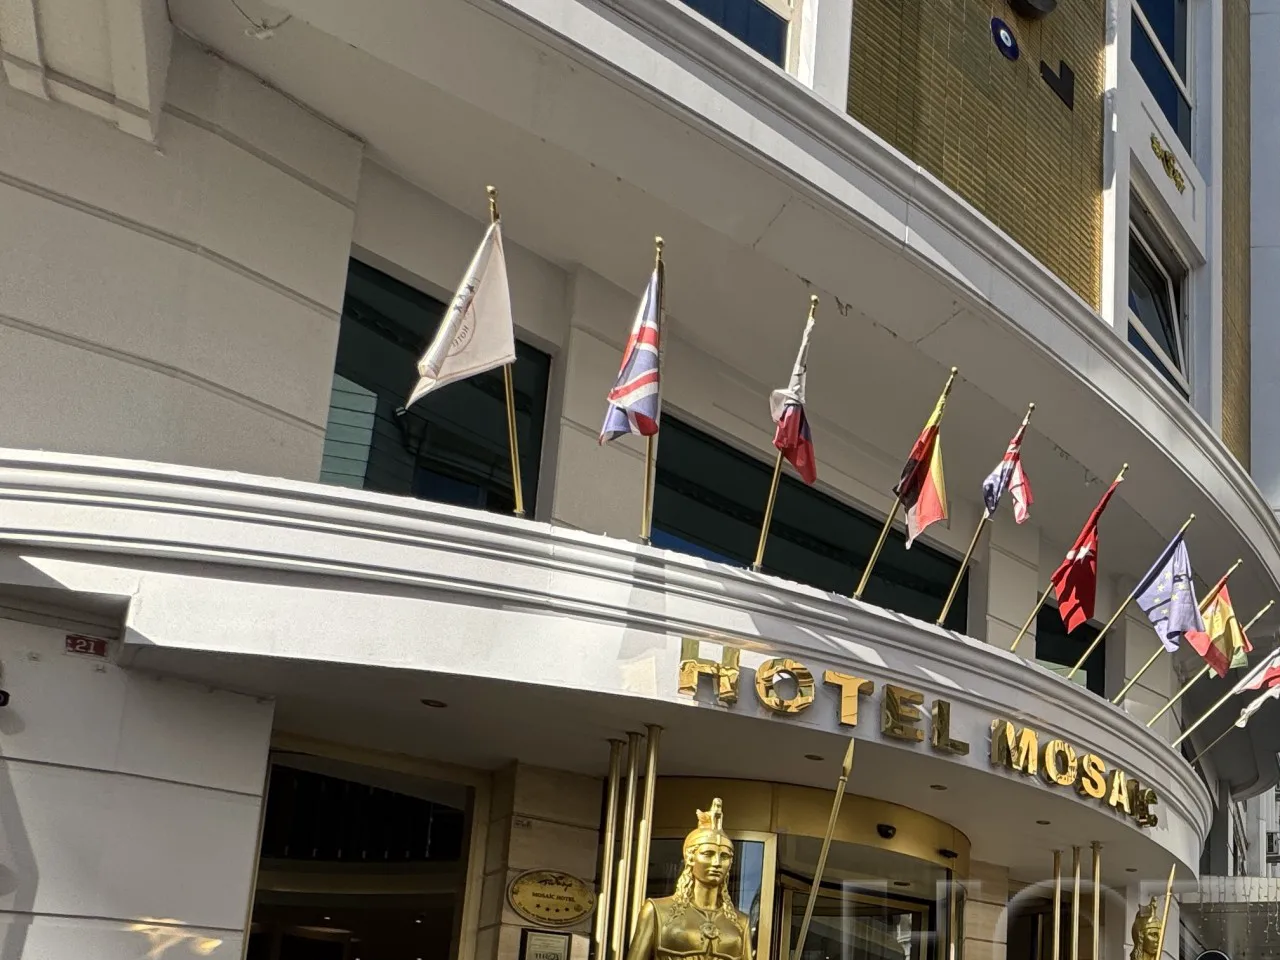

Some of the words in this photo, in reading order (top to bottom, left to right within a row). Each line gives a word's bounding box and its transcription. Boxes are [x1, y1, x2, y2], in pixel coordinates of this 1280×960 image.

[75, 639, 96, 653] 21
[679, 638, 969, 755] HOTEL
[989, 718, 1158, 828] MOSAIC
